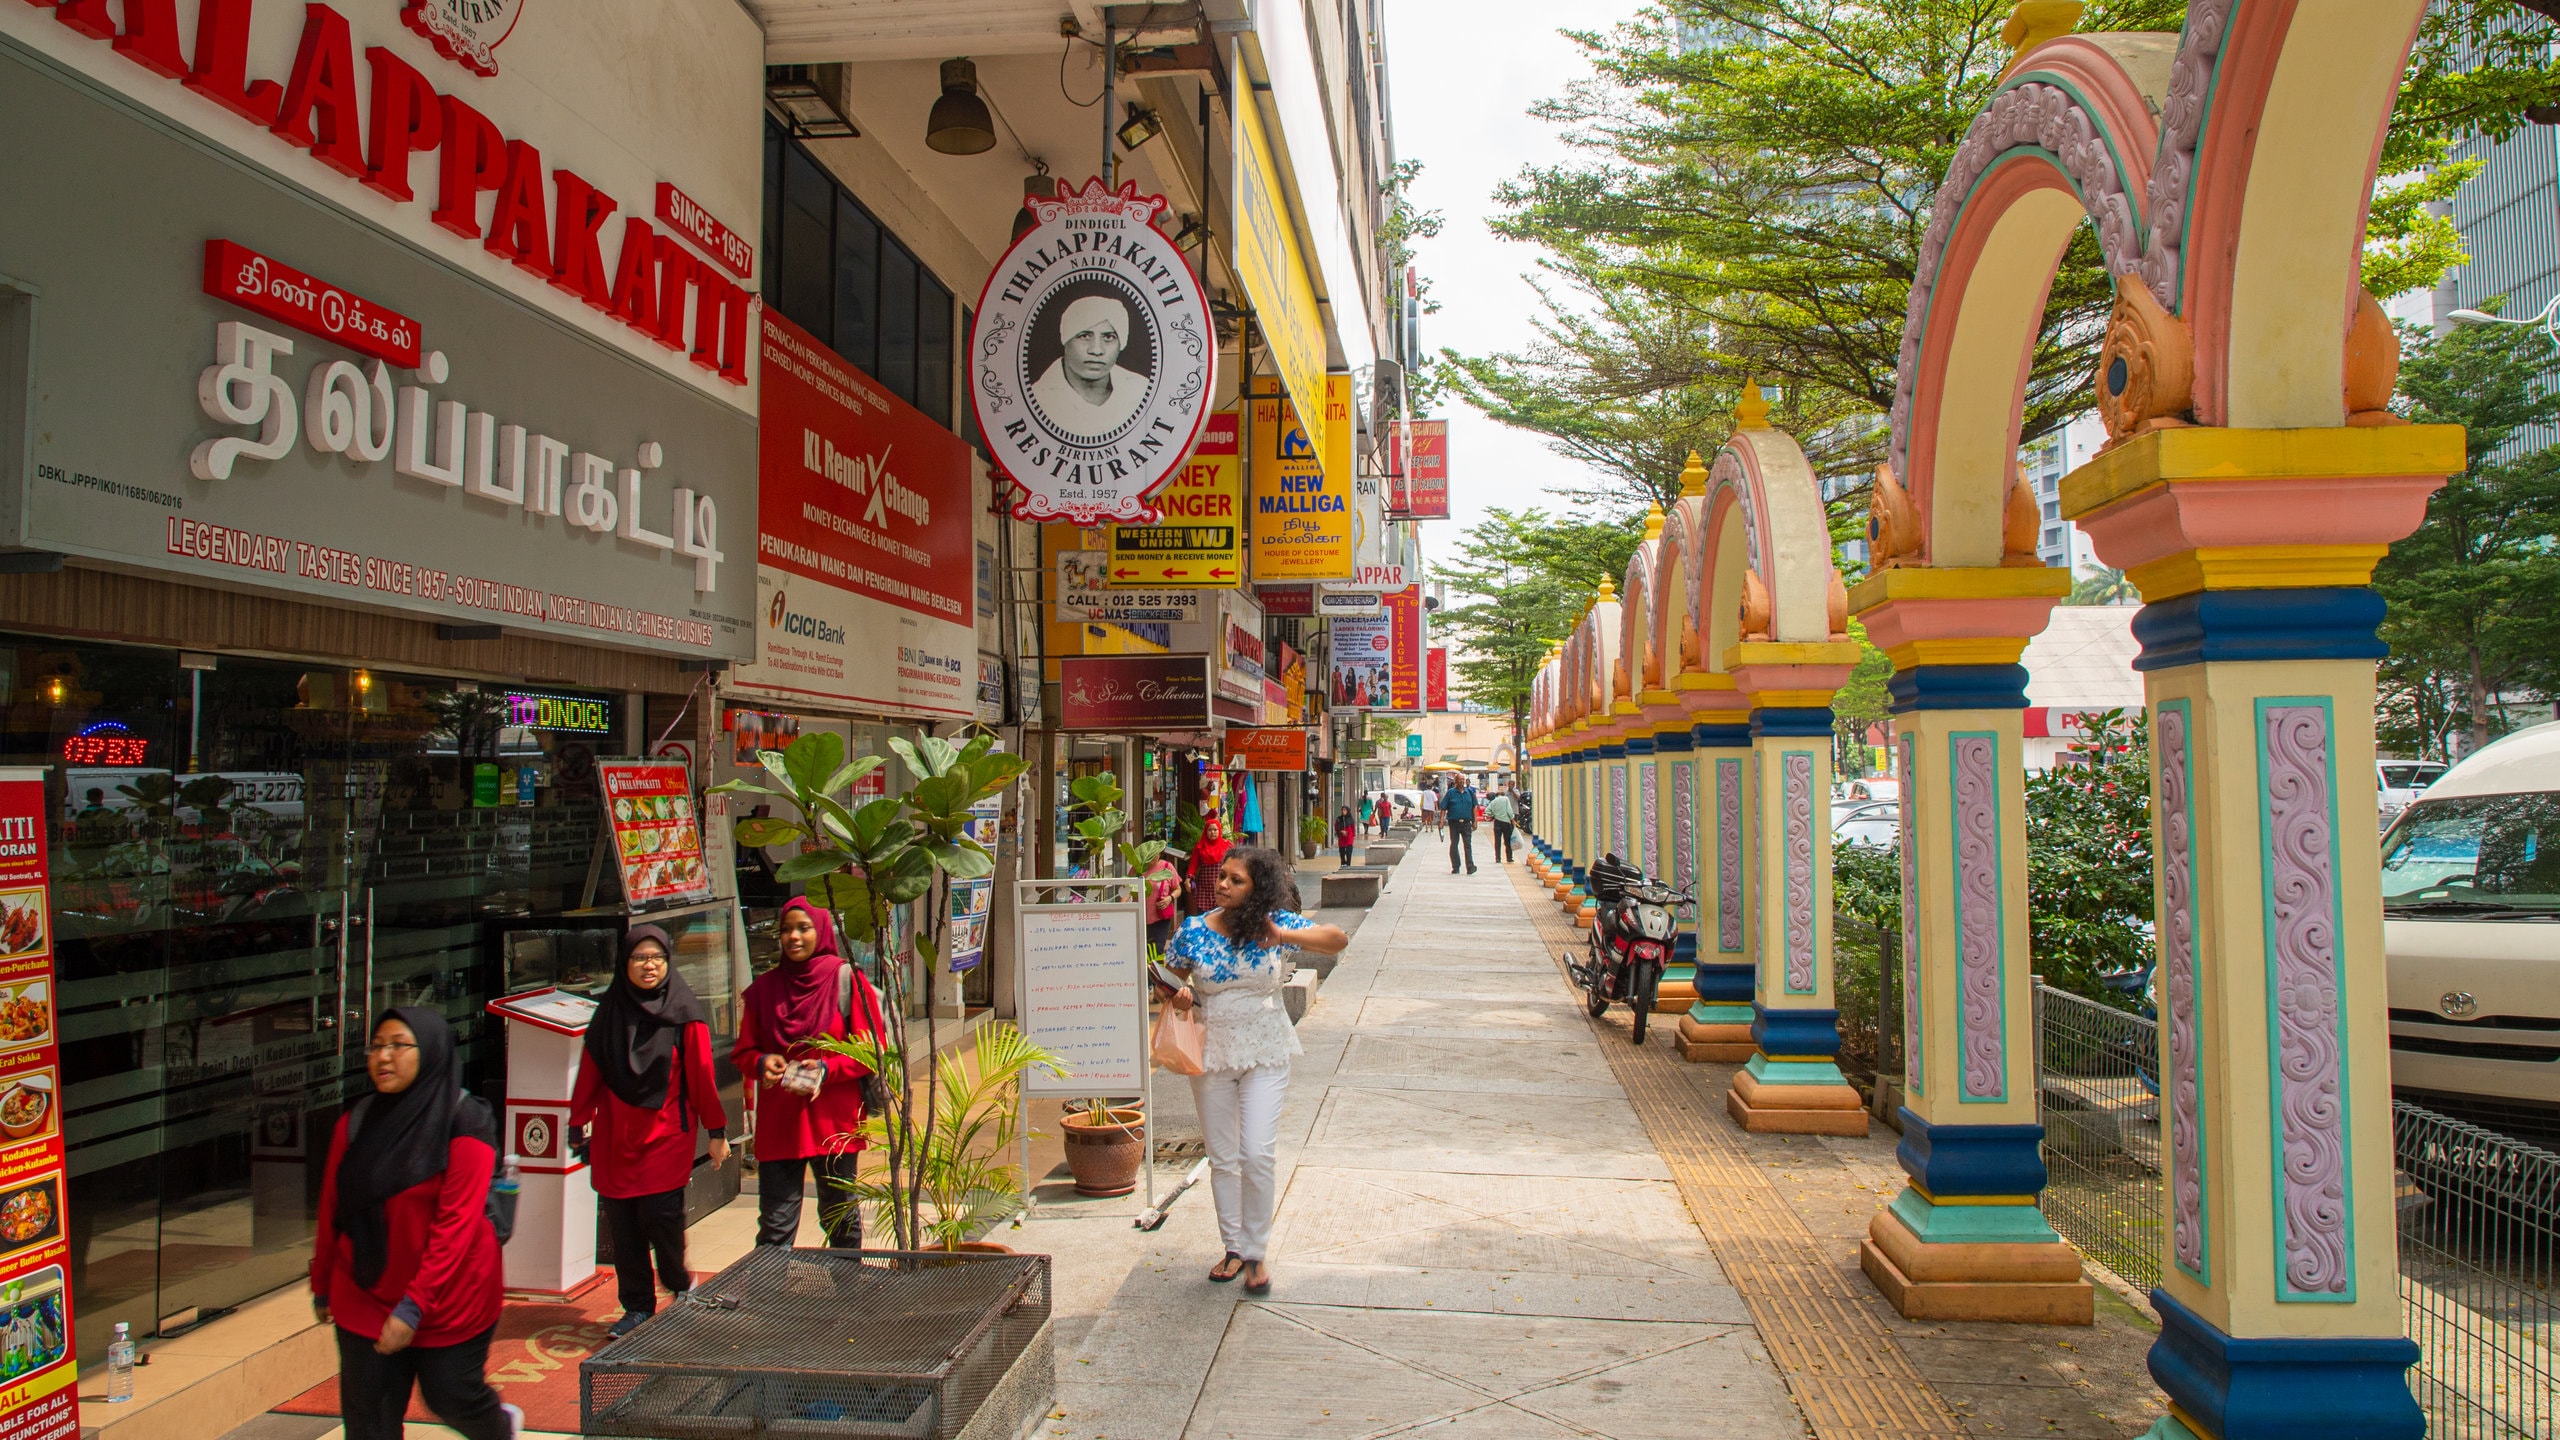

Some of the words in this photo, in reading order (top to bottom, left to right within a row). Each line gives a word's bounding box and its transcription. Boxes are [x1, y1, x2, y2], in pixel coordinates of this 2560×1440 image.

[461, 22, 477, 40] 1957
[1065, 218, 1127, 230] DINDIGUL
[1001, 231, 1185, 308] THALAPPAKATTI
[1070, 256, 1118, 270] NAIDU
[236, 256, 411, 350] திண்டுக்கல்
[764, 319, 805, 359] PERNIAGAAN
[764, 342, 791, 371] LICENSED
[793, 363, 815, 386] MONEY
[816, 373, 839, 401] SERVICES
[1200, 431, 1234, 443] ange
[190, 321, 724, 592] தலப்பாகட்டி
[1005, 417, 1175, 486] RESTAURANT
[1058, 445, 1119, 461] BIRIYANI
[804, 427, 822, 475] KL
[825, 439, 866, 496] Remit
[1424, 455, 1440, 468] HAIR
[1059, 489, 1087, 499] Estd.
[1091, 488, 1118, 499] 1957
[1281, 476, 1324, 493] NEW
[1259, 495, 1345, 514] MALLIGA
[1120, 529, 1182, 539] WESTERN
[1283, 518, 1321, 532] நியூ
[803, 502, 832, 528] MONEY
[833, 515, 871, 545] EXCHANGE
[871, 532, 876, 547] &
[878, 534, 900, 555] MONEY
[901, 544, 931, 568] TRANSFER
[1140, 539, 1182, 548] UNION
[1262, 532, 1343, 545] மல்லிகா
[167, 516, 290, 573] LEGENDARY
[297, 542, 361, 586] TASTES
[365, 557, 412, 596] SINCE
[502, 583, 546, 623] INDIAN,
[549, 593, 586, 624] NORTH
[588, 602, 623, 632] INDIAN
[626, 608, 633, 633] &
[635, 610, 673, 640] CHINESE
[675, 619, 713, 647] CUISINES
[761, 533, 818, 570] PENUKARAN
[820, 555, 845, 579] WANG
[847, 564, 863, 586] DAN
[865, 572, 909, 598] PENGIRIMAN
[910, 586, 930, 606] WANG
[931, 591, 962, 617] BERLESEN
[1067, 595, 1099, 606] CALL
[1113, 595, 1134, 606] 012
[1138, 595, 1161, 606] 525
[1167, 595, 1197, 605] 7393
[1088, 608, 1130, 620] UCMAS
[1131, 609, 1183, 620] BRICKFIELDS
[784, 611, 816, 638] ICICI
[818, 621, 845, 645] Bank
[925, 655, 935, 664] BANK
[951, 659, 961, 672] BCA
[898, 666, 923, 681] PENGIRIMAN
[1136, 679, 1204, 701] Collections
[508, 695, 535, 724] TO
[1258, 735, 1289, 746] SREE
[64, 737, 148, 764] OPEN
[0, 816, 35, 840] TTI
[17, 1053, 41, 1064] Sukka
[2, 1143, 47, 1163] Kodaikanal
[20, 1252, 42, 1268] Butter
[44, 1244, 66, 1259] Masala
[27, 1403, 49, 1420] FOR
[50, 1394, 69, 1410] ALL
